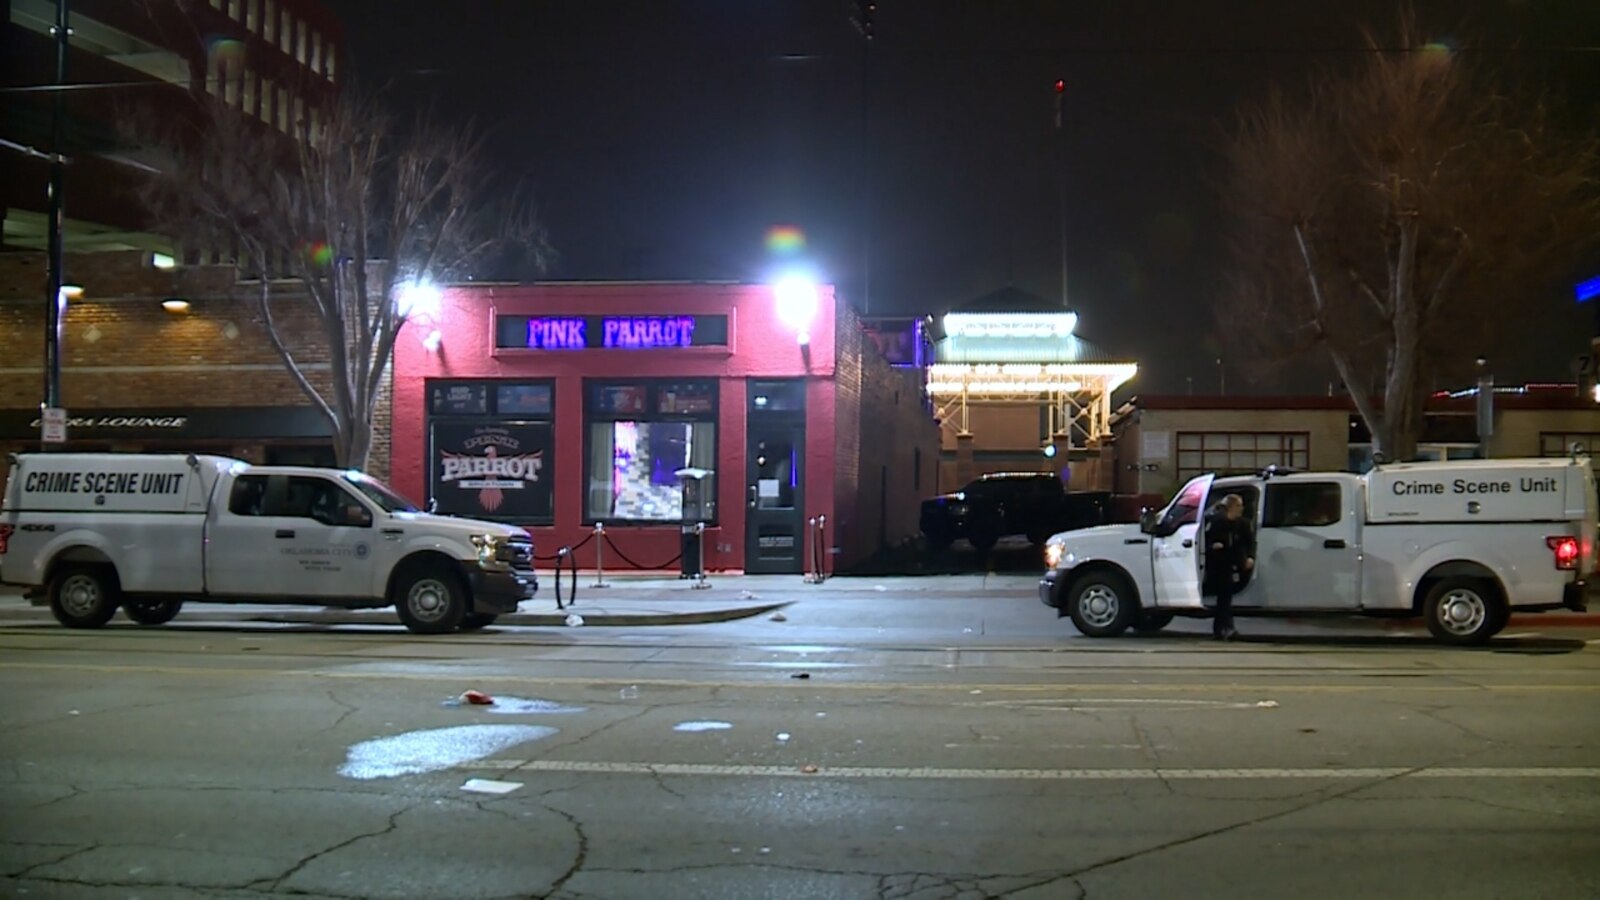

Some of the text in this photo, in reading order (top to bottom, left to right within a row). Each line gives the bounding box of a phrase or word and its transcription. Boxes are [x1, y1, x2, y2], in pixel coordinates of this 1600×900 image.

[527, 316, 695, 348] PINK PARROT
[98, 417, 187, 428] LOUNGE
[441, 457, 543, 482] PARROT
[25, 471, 184, 494] CRIME SCENE UNIT
[1392, 477, 1558, 495] Crime Scene Unit
